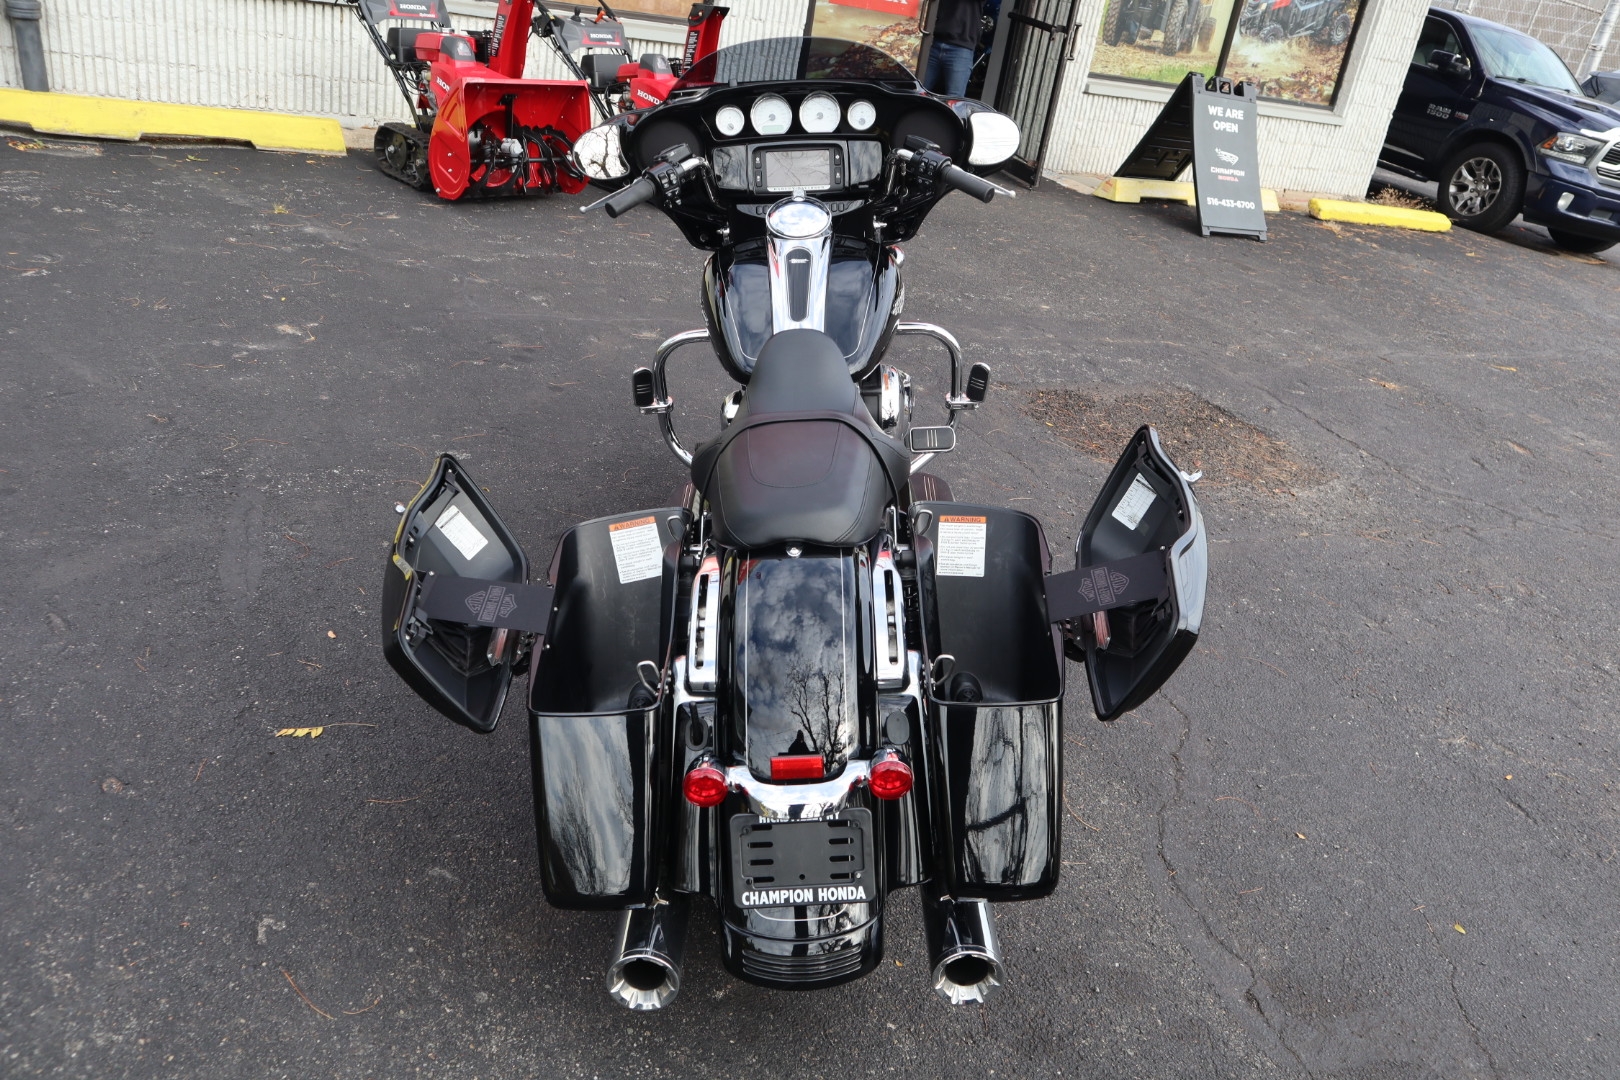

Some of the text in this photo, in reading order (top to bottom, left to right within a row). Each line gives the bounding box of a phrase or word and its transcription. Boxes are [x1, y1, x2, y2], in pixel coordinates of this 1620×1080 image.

[399, 3, 427, 11] HONDA
[436, 76, 450, 93] HON
[637, 89, 663, 105] HOND
[1207, 104, 1244, 120] WE ARE
[1426, 108, 1449, 119] 1500
[1428, 103, 1452, 114] RAM
[1213, 120, 1239, 133] OPEN
[1210, 166, 1245, 177] CHAMPION
[1206, 197, 1256, 210] 516-433-6700
[619, 518, 651, 529] WARNING
[741, 885, 866, 905] CHAMPION HONDA
